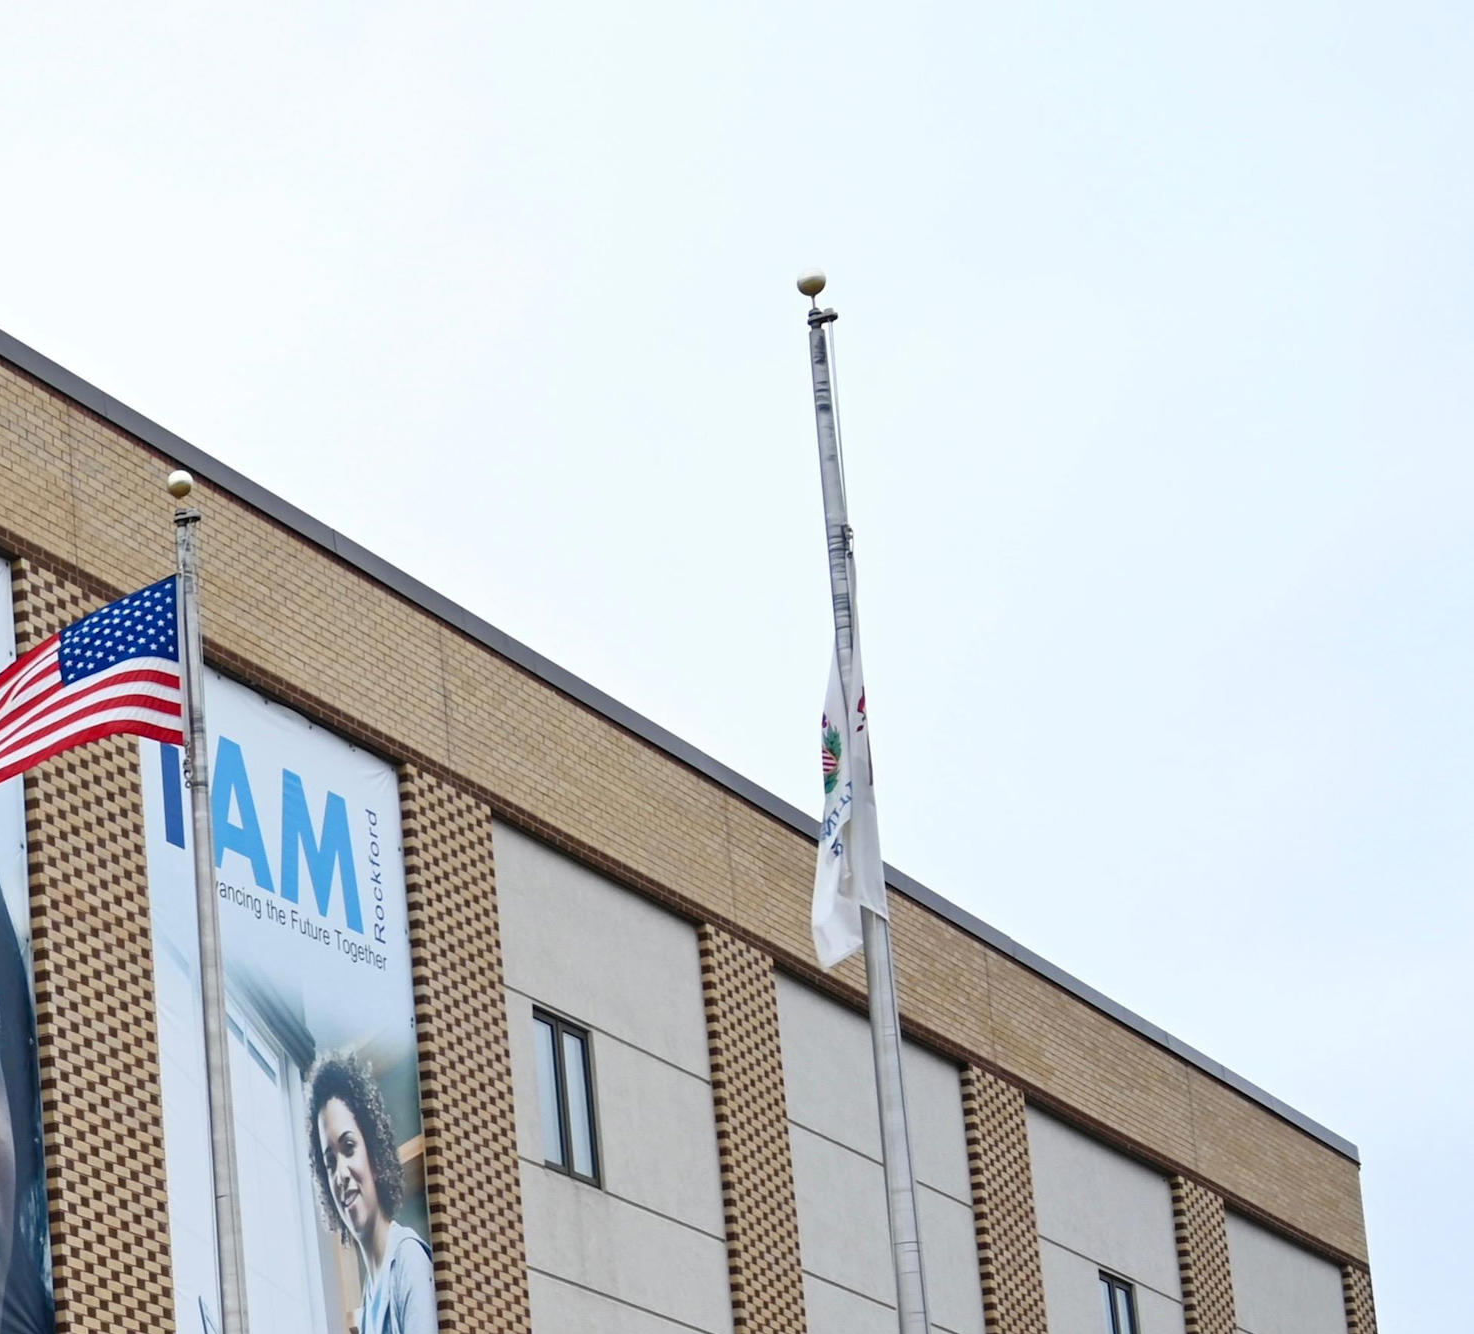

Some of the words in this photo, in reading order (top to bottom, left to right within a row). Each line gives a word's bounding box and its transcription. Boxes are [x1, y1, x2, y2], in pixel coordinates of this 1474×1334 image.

[215, 881, 262, 919] ancing
[266, 900, 286, 926] the
[291, 910, 330, 945] Future
[334, 928, 387, 971] Together
[365, 808, 386, 944] Rockford
